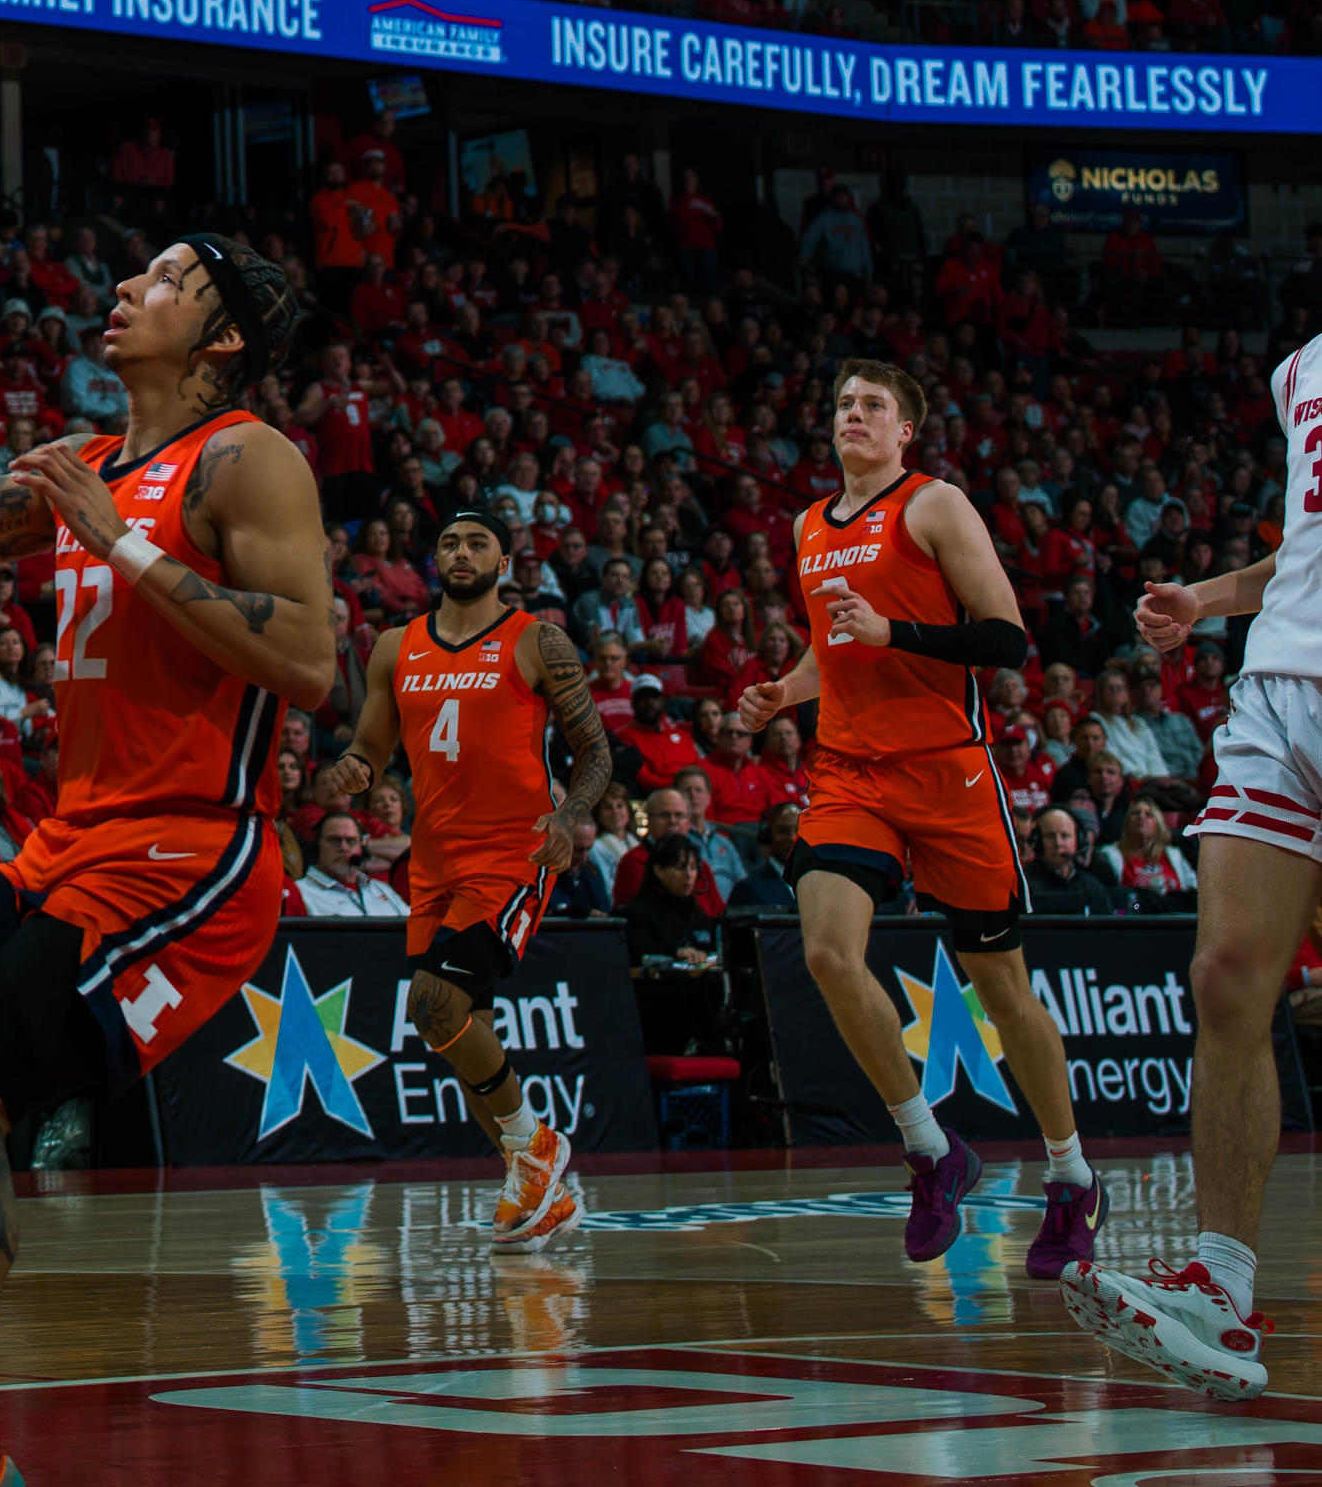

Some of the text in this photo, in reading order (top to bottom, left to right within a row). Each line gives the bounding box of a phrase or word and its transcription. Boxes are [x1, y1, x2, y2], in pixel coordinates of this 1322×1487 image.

[371, 15, 501, 44] AMERICAN FAMILY
[551, 16, 1268, 115] INSURE CAREFULLY, DREAM FEARLESSLY
[1081, 166, 1221, 194] NICHOLAS
[1120, 192, 1180, 207] FUNDS
[799, 543, 883, 577] ILLINOIS
[55, 564, 114, 682] 22
[401, 671, 501, 693] ILLINOIS
[428, 698, 461, 763] 4
[390, 979, 586, 1053] Aant
[1069, 1054, 1193, 1117] nergy
